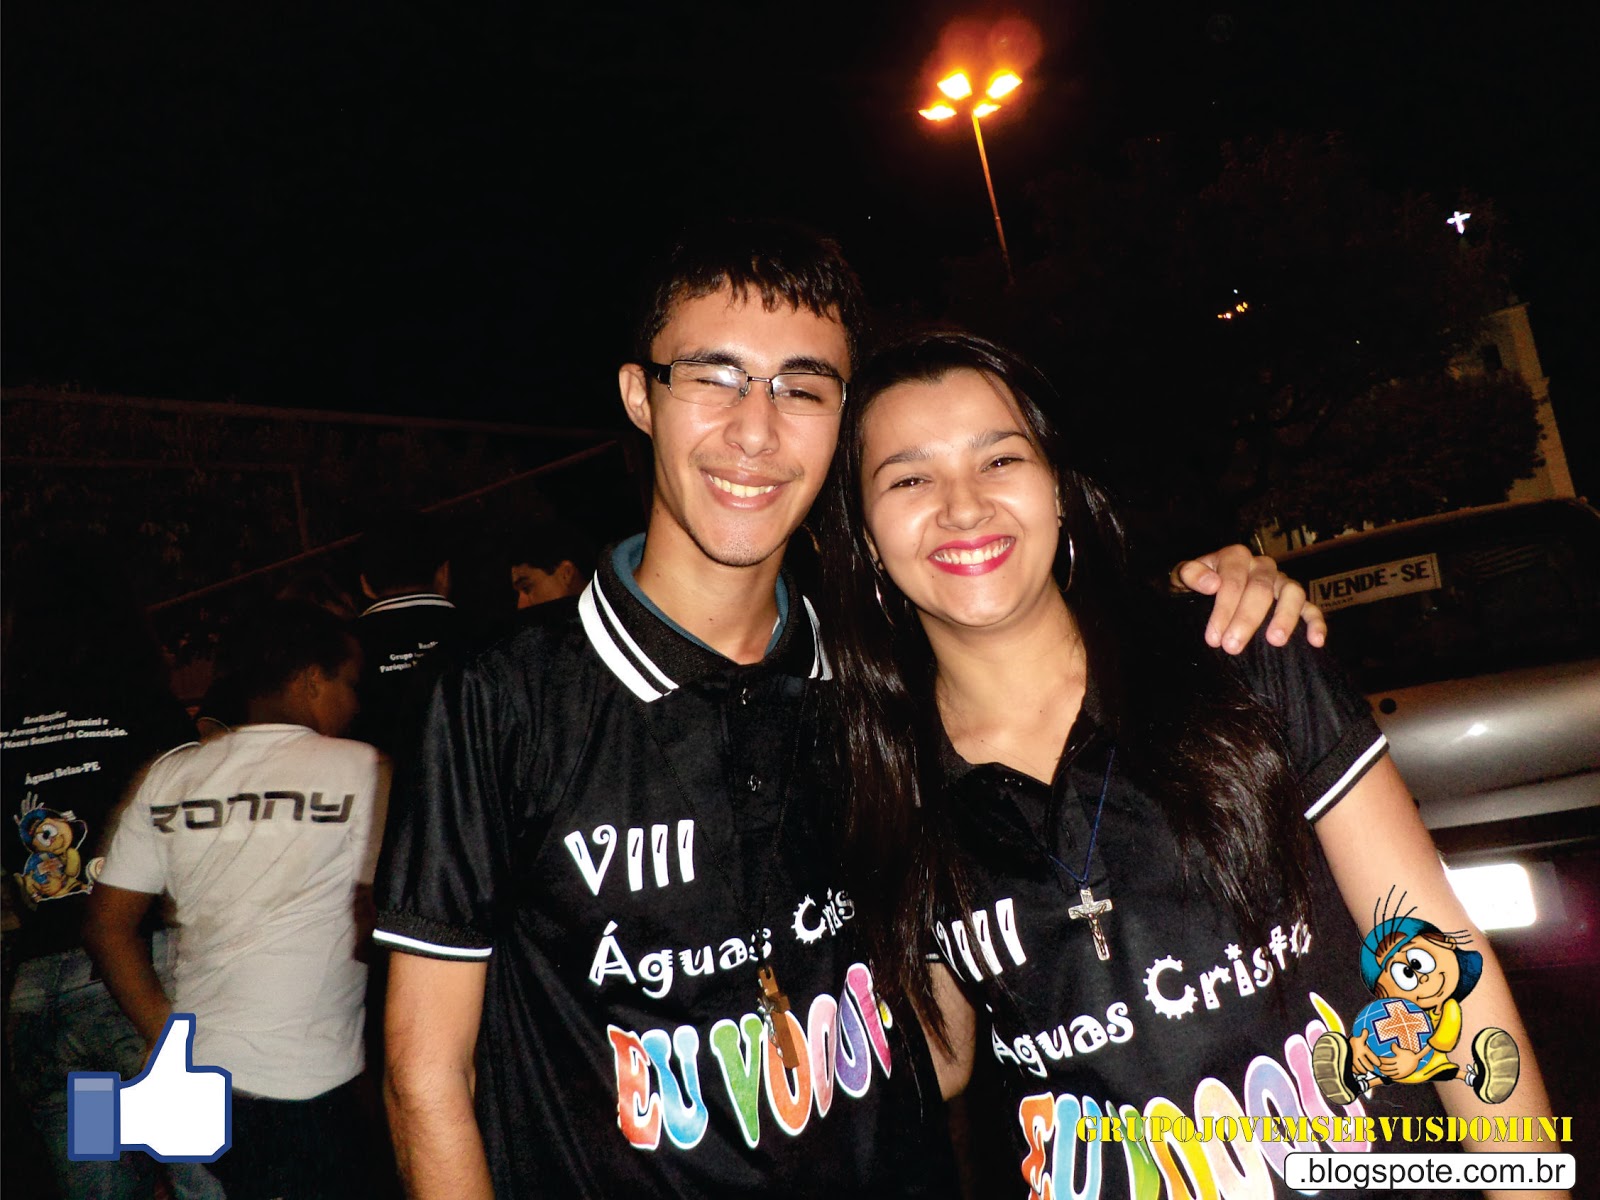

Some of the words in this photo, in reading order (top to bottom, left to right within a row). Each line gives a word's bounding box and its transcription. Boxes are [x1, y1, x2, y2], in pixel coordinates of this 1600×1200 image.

[564, 819, 695, 896] VIII
[589, 920, 772, 999] Águas
[985, 1002, 1134, 1078] Águas
[1142, 918, 1312, 1020] Cristo
[606, 1024, 709, 1150] EU
[1019, 1091, 1102, 1200] EU
